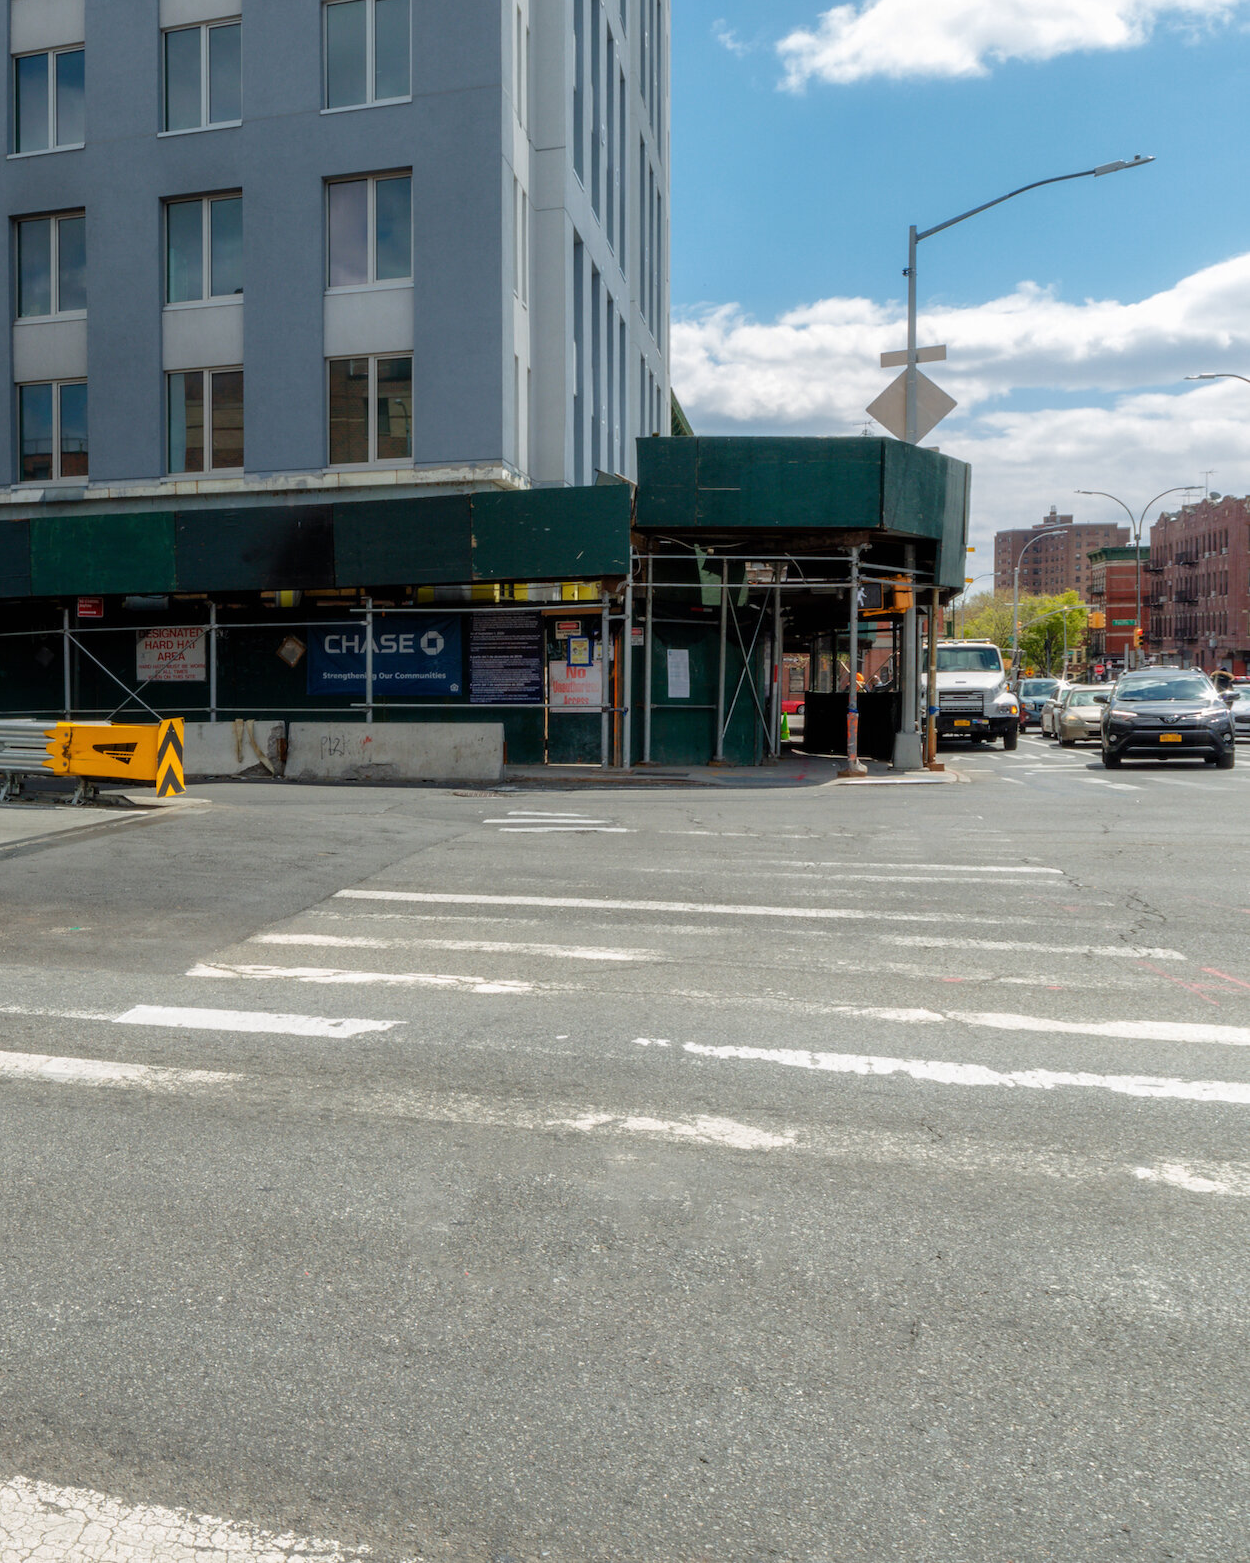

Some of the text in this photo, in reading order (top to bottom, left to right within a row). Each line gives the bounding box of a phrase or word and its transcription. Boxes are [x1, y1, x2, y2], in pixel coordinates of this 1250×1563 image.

[138, 628, 204, 638] DESIGNATED
[144, 640, 196, 650] HARD HAT
[324, 634, 415, 654] CHASE
[158, 652, 185, 661] AREA
[322, 672, 377, 681] Strengthenig
[566, 666, 586, 678] No
[564, 696, 589, 705] Access
